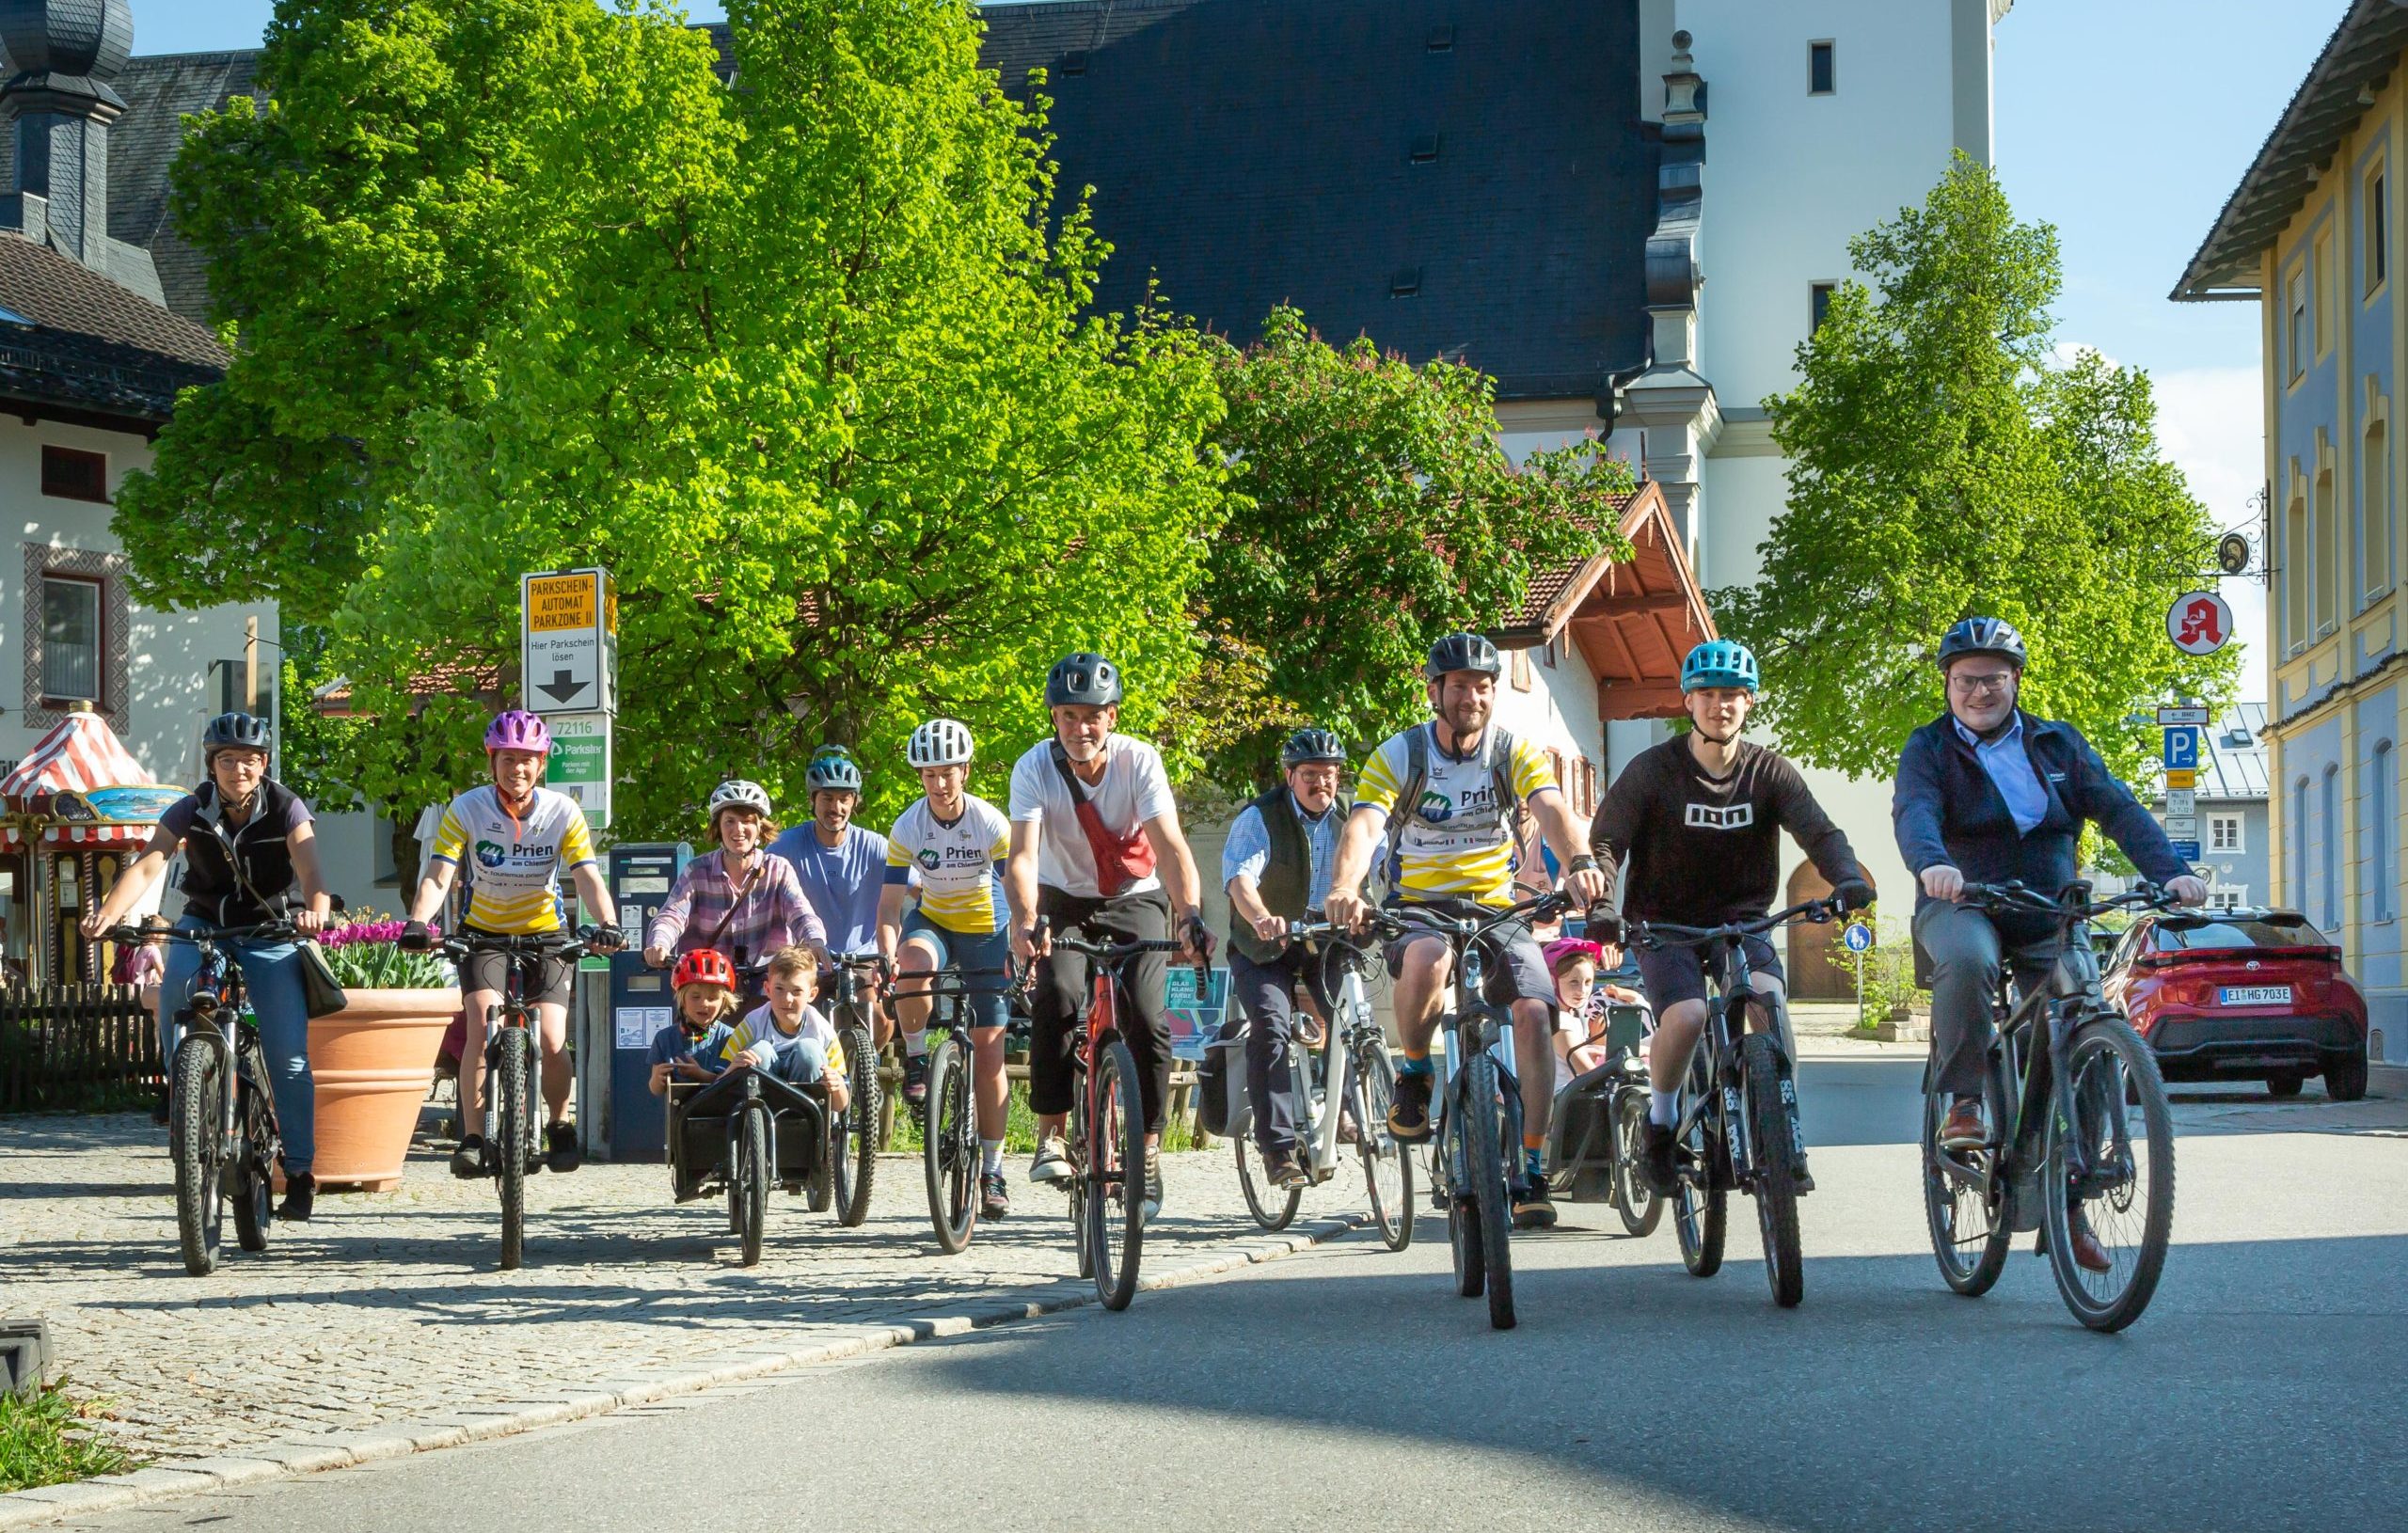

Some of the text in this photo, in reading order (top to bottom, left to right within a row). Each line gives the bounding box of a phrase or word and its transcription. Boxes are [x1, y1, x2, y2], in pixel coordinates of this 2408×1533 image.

[531, 579, 593, 596] PARKSCHEIN-
[542, 595, 583, 611] AUTOMAT
[534, 611, 592, 628] PARKZONE II
[550, 639, 594, 649] Parkschein
[552, 653, 574, 661] lösen
[557, 721, 593, 735] 72116
[565, 745, 602, 754] Parkster
[2172, 733, 2190, 764] P
[512, 844, 553, 857] Prien
[946, 846, 982, 859] Prien
[2227, 988, 2289, 1001] EI HG 703E
